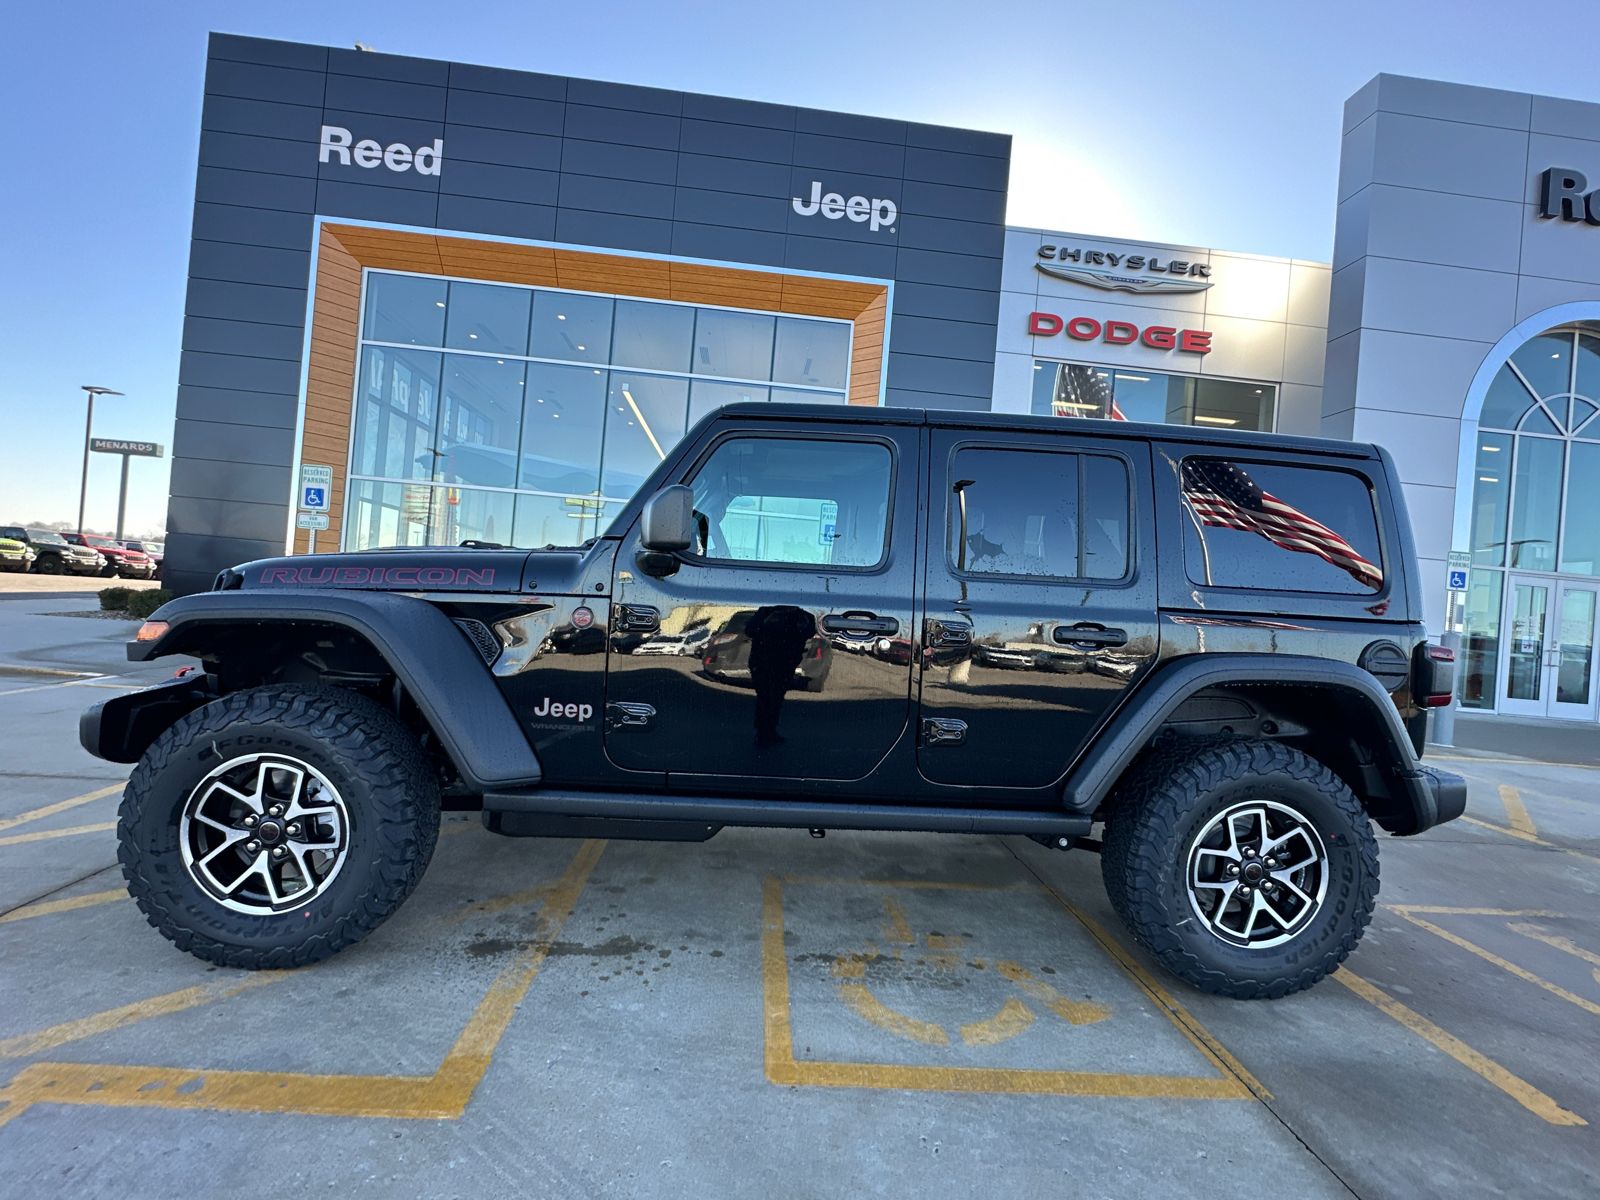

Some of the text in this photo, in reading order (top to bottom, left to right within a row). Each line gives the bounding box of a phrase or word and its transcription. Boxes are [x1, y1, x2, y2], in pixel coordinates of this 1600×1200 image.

[319, 125, 443, 176] Reed
[793, 181, 897, 232] Jeep
[1038, 245, 1212, 277] CHRYSLER
[1029, 311, 1213, 353] DODGE
[95, 440, 153, 452] MENARDS
[304, 468, 328, 476] RESERVED
[260, 567, 496, 586] RUBICON
[534, 697, 593, 722] Jeep
[531, 722, 585, 731] WRANGLER
